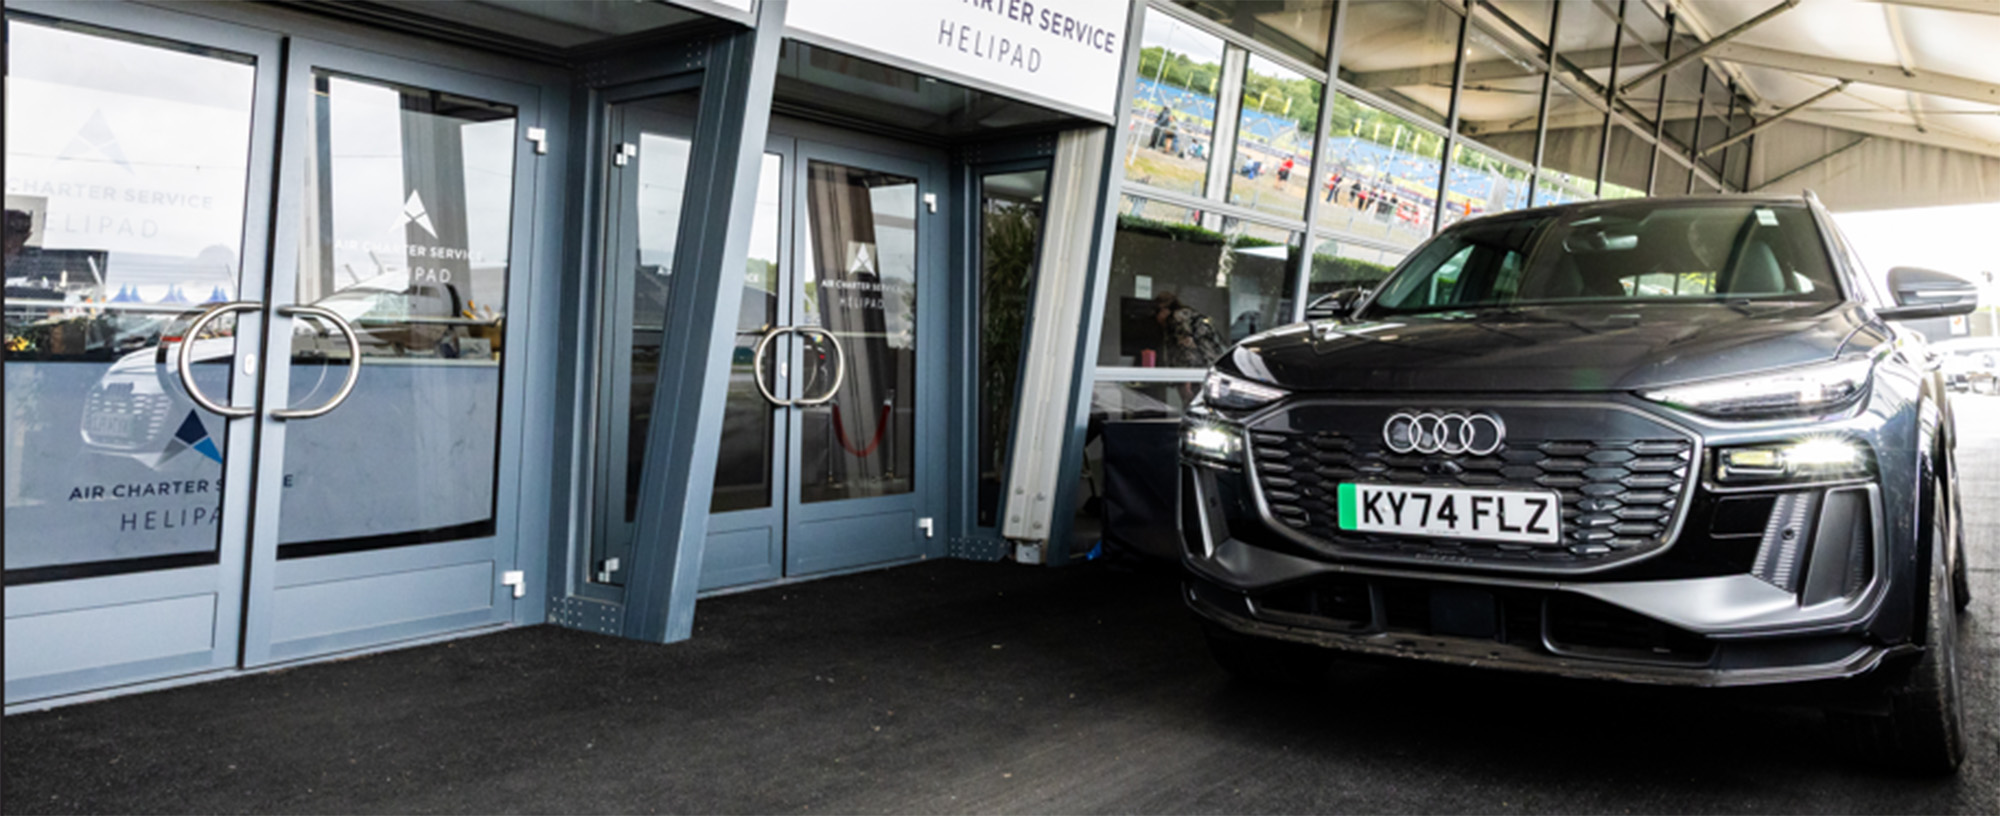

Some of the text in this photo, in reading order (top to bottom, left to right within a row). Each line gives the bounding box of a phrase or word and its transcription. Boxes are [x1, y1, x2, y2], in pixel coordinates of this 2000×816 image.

[1039, 8, 1116, 54] SERVICE
[938, 19, 1041, 73] HELIPAD
[123, 187, 214, 211] SERVICE
[44, 211, 159, 239] ELIPAD
[836, 280, 871, 291] CHARTER
[69, 485, 104, 501] AIR
[112, 479, 209, 498] CHARTER
[120, 505, 221, 532] HELIPA
[1362, 490, 1550, 534] KY74 FLZ
